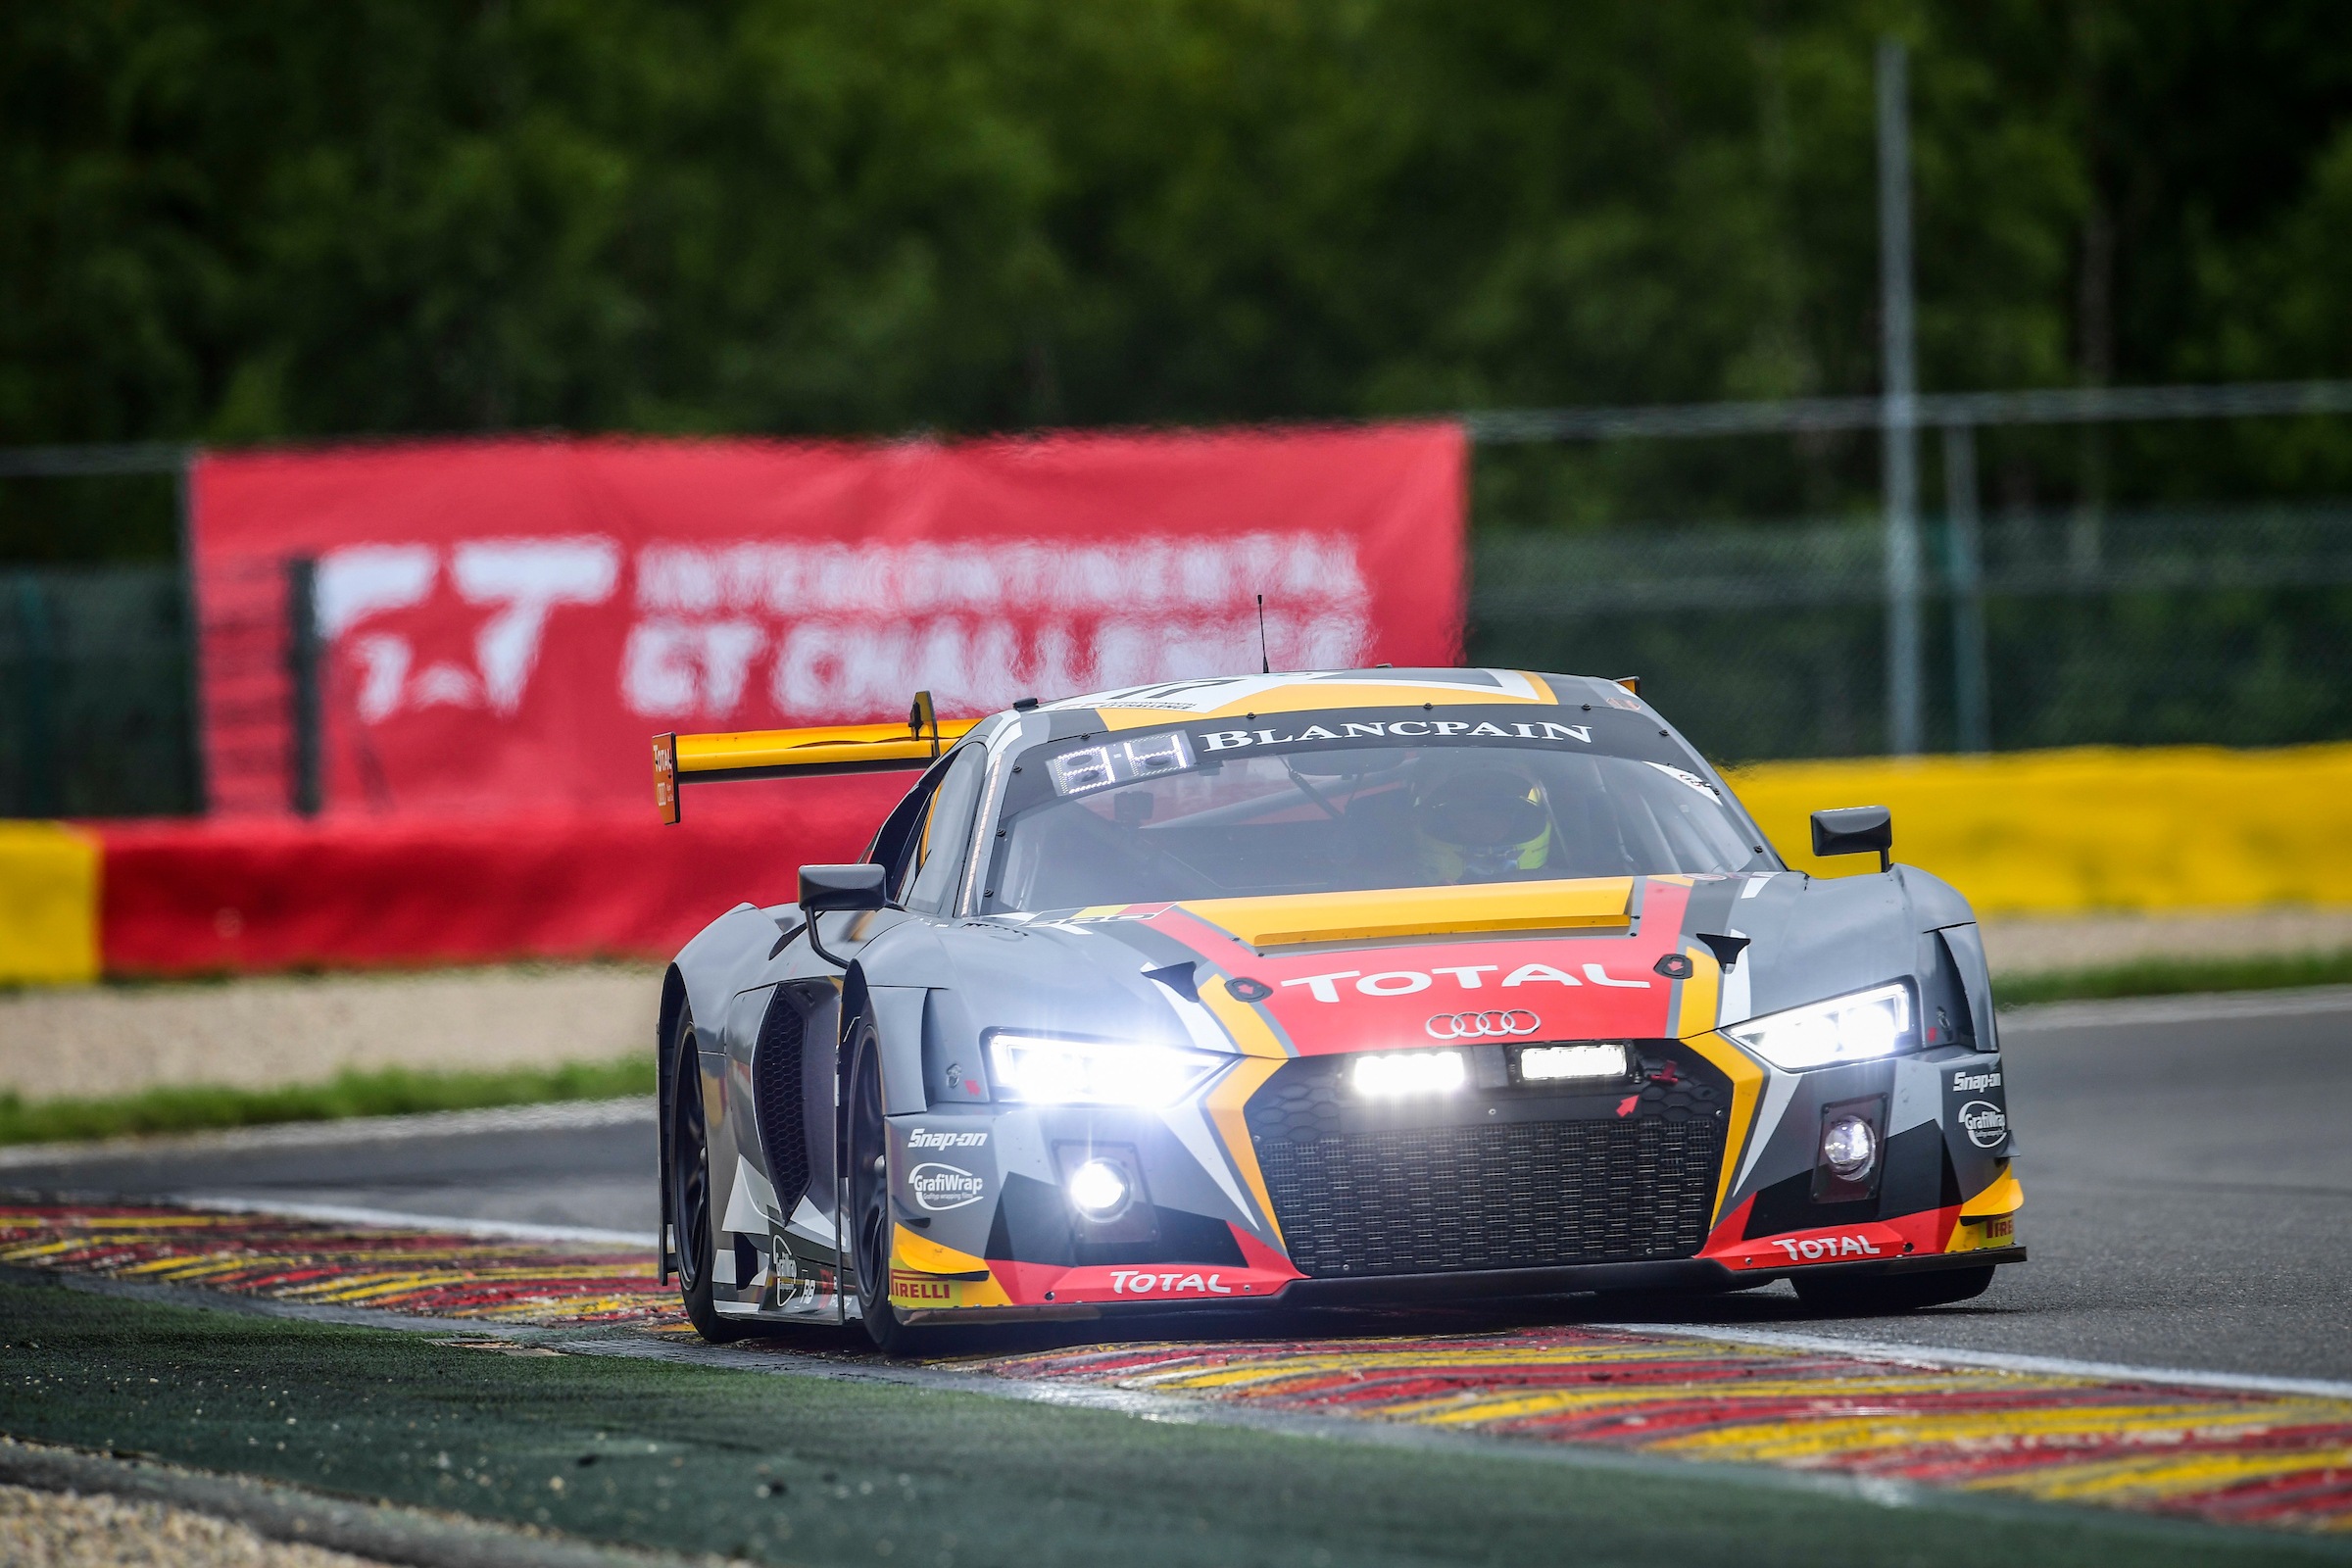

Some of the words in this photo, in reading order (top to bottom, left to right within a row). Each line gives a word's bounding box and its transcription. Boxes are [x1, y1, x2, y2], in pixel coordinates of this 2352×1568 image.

[1199, 720, 1592, 753] BLANCPAIN
[1281, 963, 1651, 1004] TOTAL
[907, 1128, 988, 1152] Snap-on
[914, 1173, 983, 1195] GrafiWrap
[1771, 1235, 1880, 1260] TOTAL
[890, 1269, 951, 1298] PIRELLI
[1109, 1270, 1231, 1294] TOTAL
